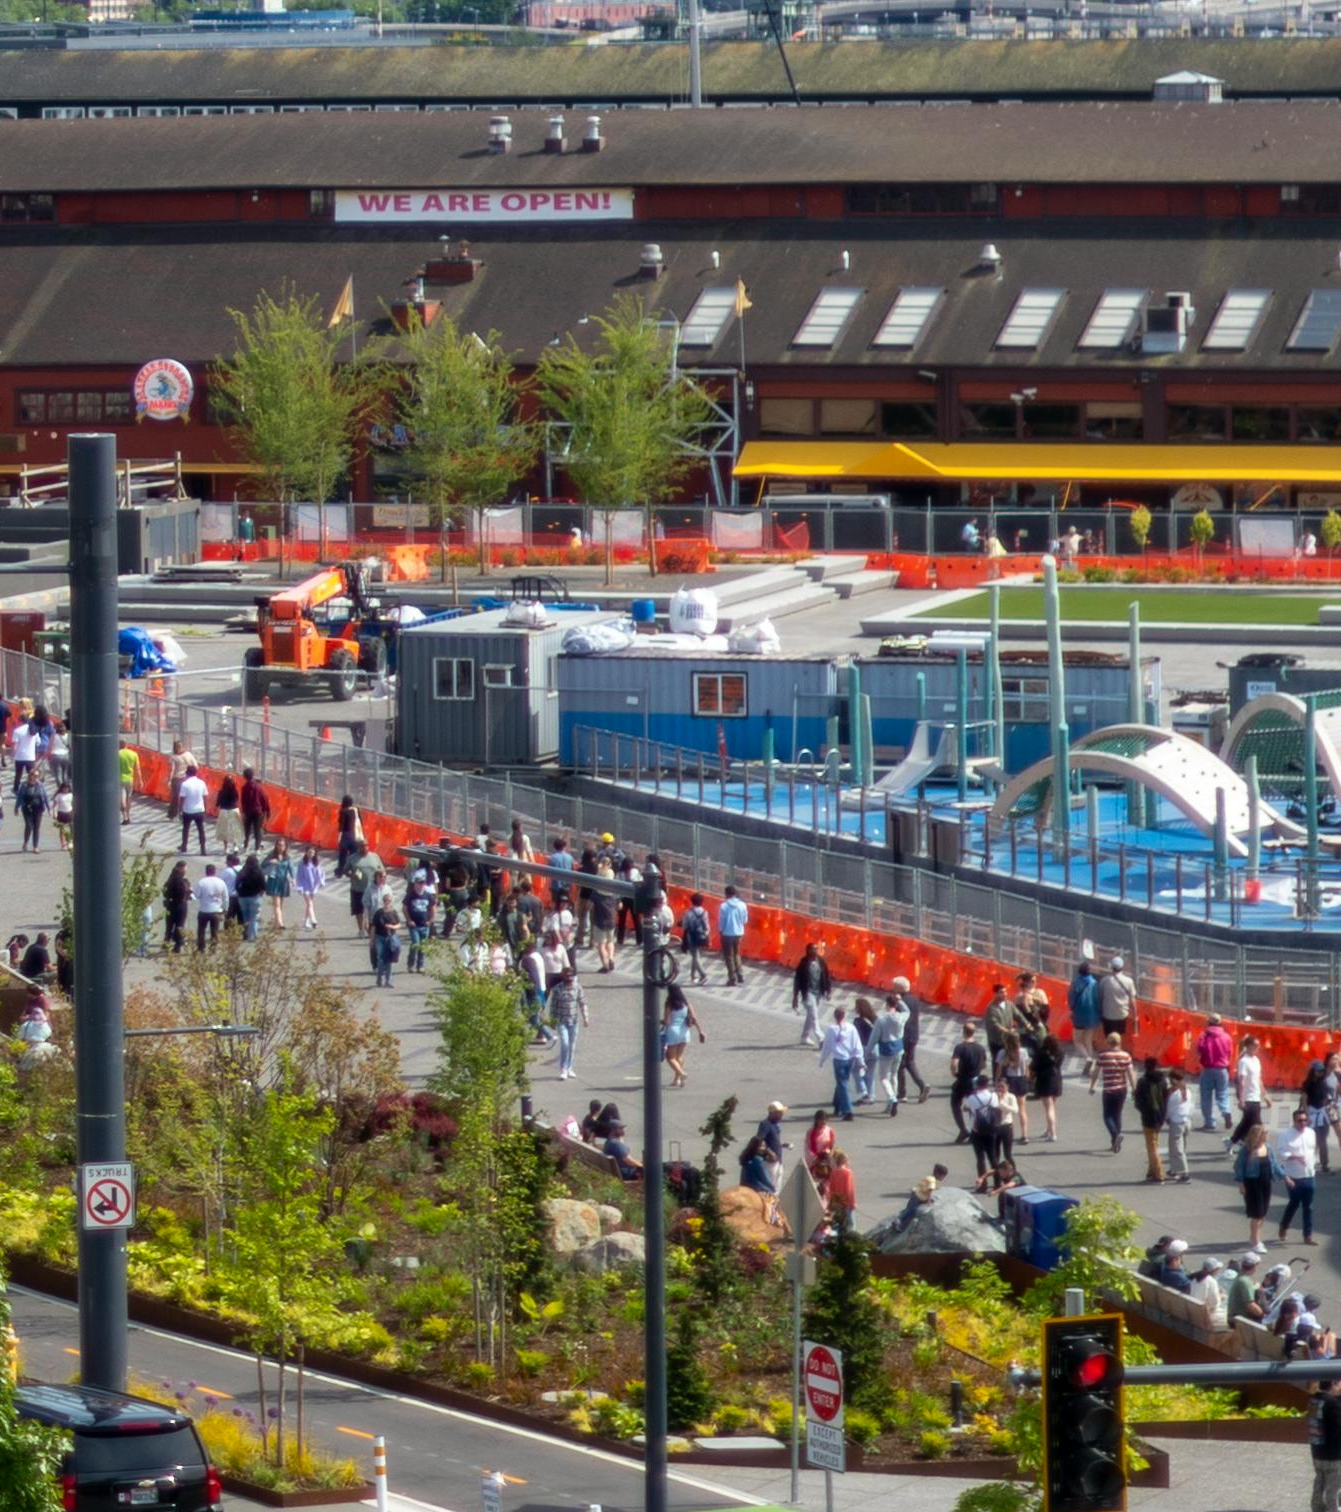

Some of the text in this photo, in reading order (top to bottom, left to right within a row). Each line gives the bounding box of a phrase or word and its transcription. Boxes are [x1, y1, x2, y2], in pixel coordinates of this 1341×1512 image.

[358, 192, 611, 213] WE ARE OPEN!
[88, 1166, 128, 1178] TRUCKS
[808, 1358, 836, 1377] DO NOT
[812, 1391, 835, 1409] ENTER
[813, 1424, 837, 1442] EXCEPT
[812, 1450, 840, 1468] VEHICLES
